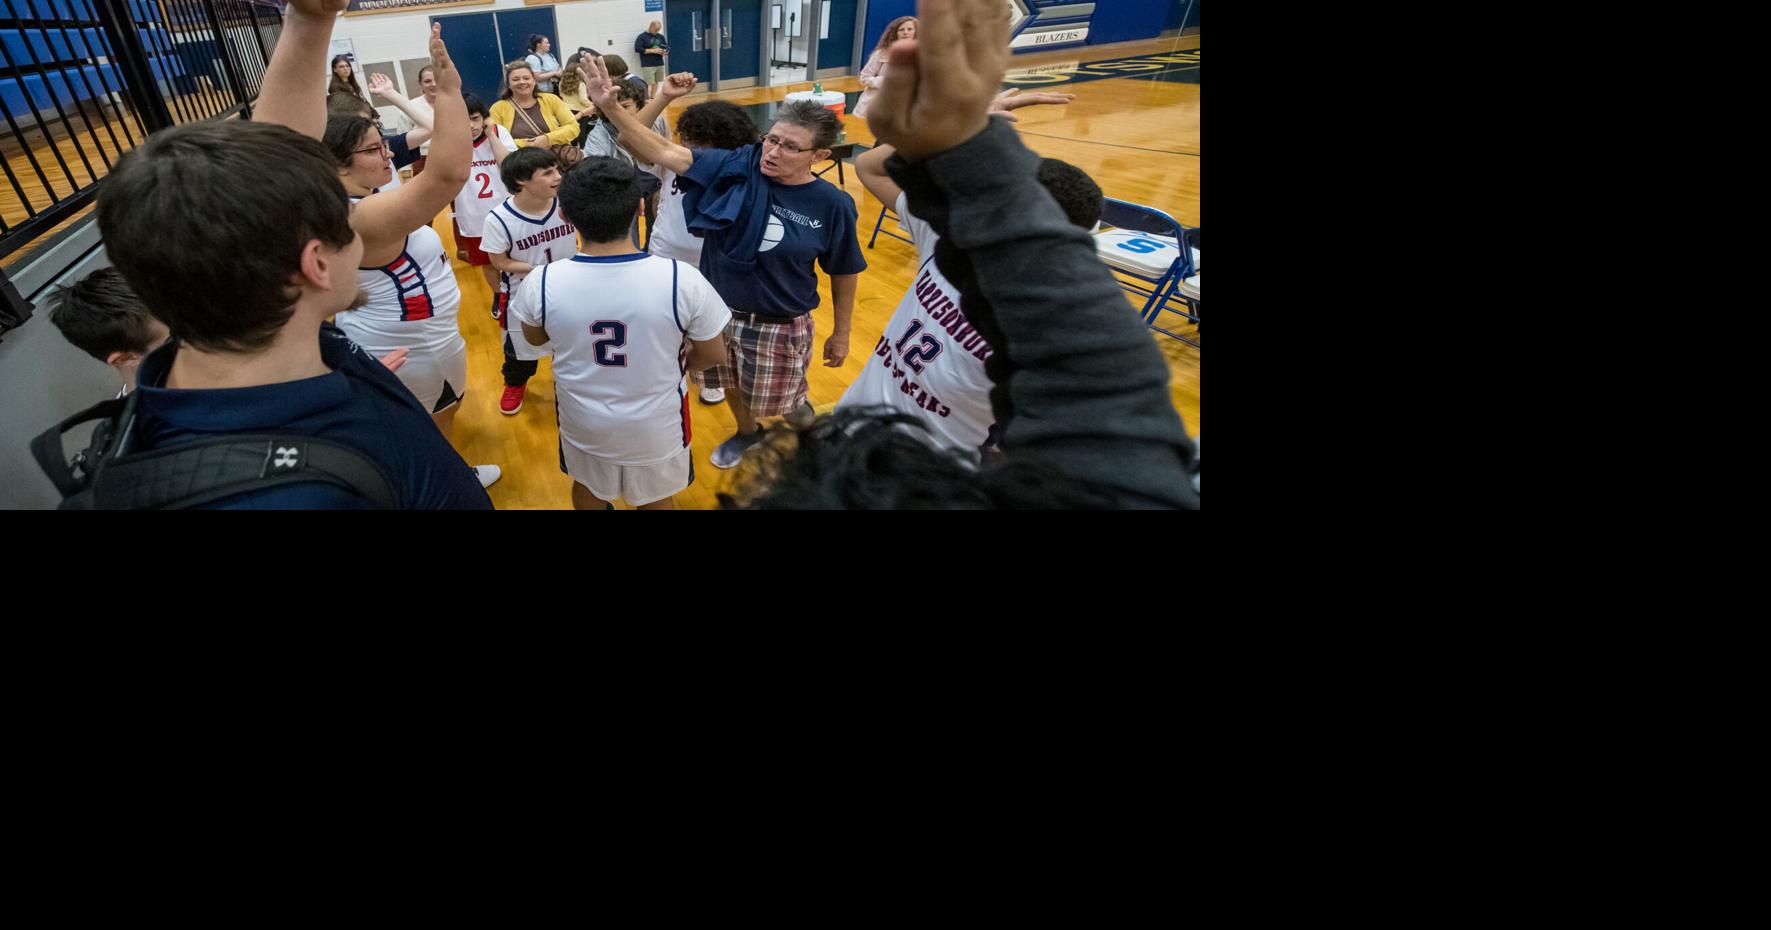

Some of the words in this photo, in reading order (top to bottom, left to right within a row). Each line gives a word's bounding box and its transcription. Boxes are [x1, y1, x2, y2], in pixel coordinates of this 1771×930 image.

[1034, 31, 1079, 44] BLAZERS
[475, 173, 493, 199] 2
[543, 248, 553, 264] 1
[589, 319, 628, 368] 2
[895, 318, 943, 376] 12
